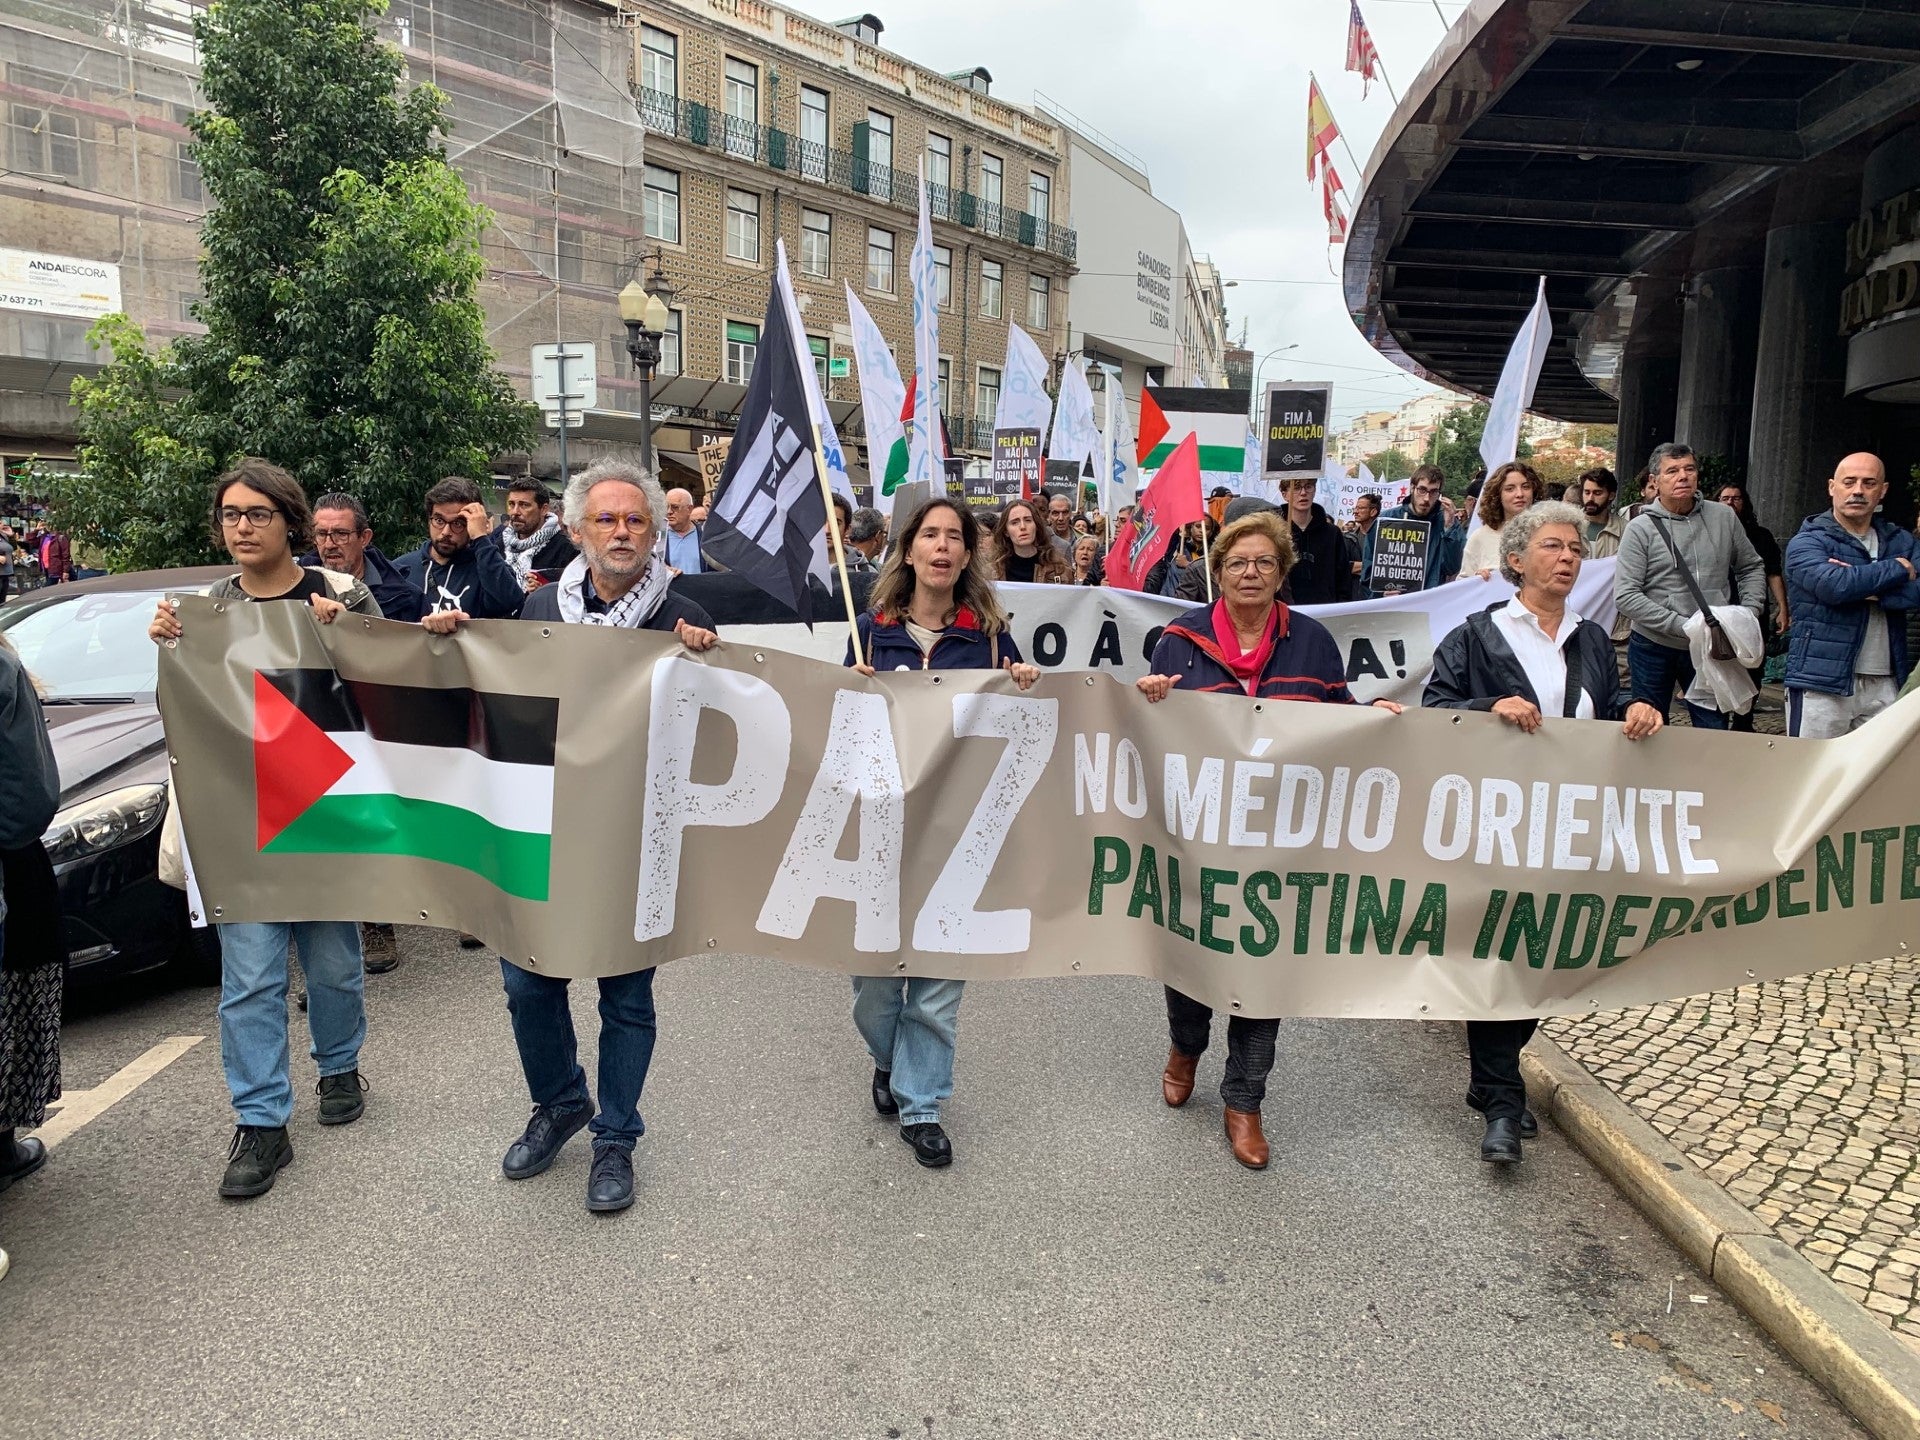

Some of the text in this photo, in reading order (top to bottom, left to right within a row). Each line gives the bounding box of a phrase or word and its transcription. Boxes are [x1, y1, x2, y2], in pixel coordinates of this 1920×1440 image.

[29, 260, 107, 279] ANDAIESCORA
[1137, 250, 1171, 281] SAPADORES
[1137, 271, 1171, 301] BOMBEIROS
[9, 296, 26, 304] 637
[28, 298, 43, 306] 271
[1150, 309, 1170, 330] LISBOA
[1284, 410, 1313, 425] FIM À
[1270, 424, 1323, 440] OCUPAÇÃO
[998, 437, 1018, 447] PELA
[700, 447, 725, 461] THE
[1005, 447, 1020, 458] NÃO
[995, 470, 1039, 481] DA GURA
[974, 486, 985, 494] FIM
[1356, 486, 1392, 496] ORIENTE
[966, 496, 1000, 505] OCUPAÇÃO
[1381, 528, 1425, 543] PELA PAZ!
[1388, 541, 1406, 554] NÃO
[1377, 554, 1423, 568] ESCALADA
[1373, 566, 1423, 581] DA GUERRA
[1088, 609, 1124, 668] À
[634, 656, 1720, 954] PAZ NO MÉDIO ORIENTE
[1088, 836, 1446, 957] PALESTINA
